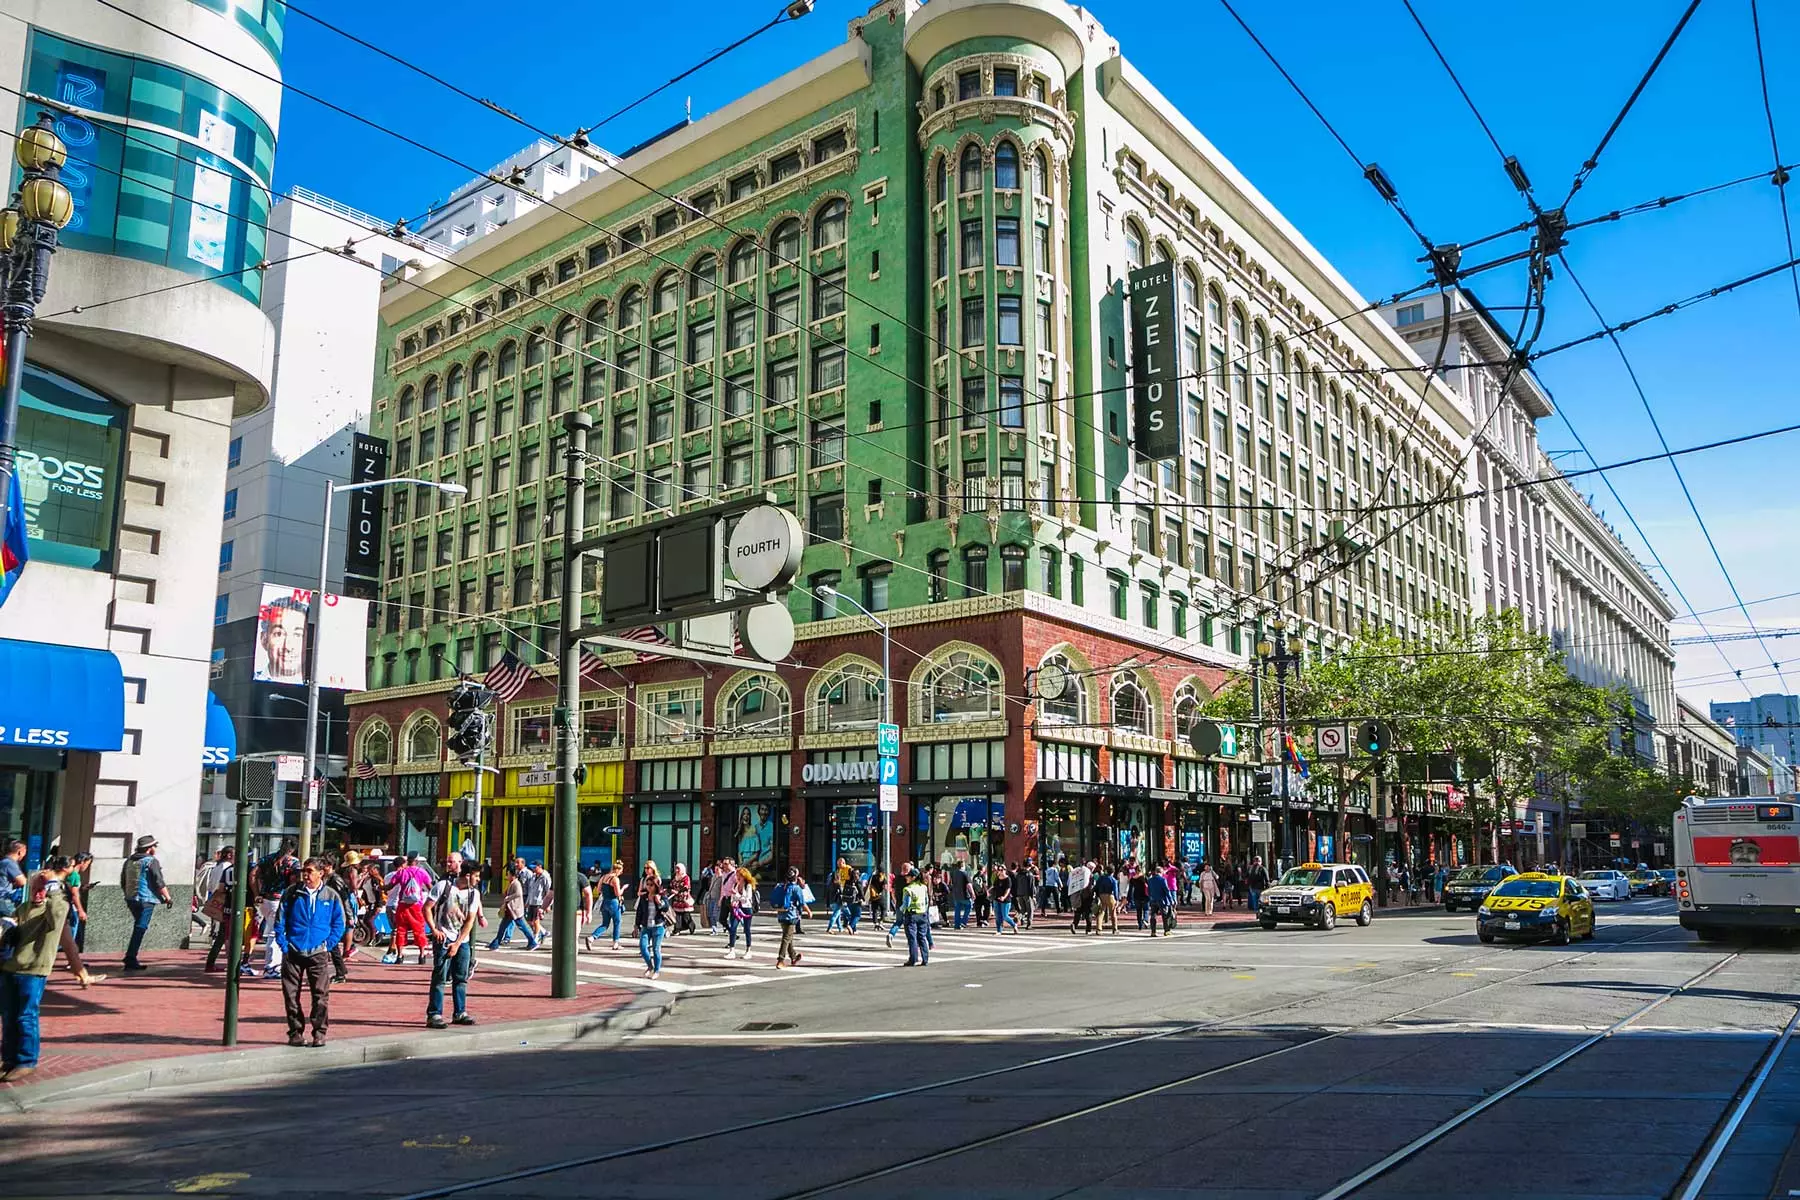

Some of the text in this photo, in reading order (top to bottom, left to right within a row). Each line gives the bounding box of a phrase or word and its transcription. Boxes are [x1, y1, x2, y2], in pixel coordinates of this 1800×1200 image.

[1134, 273, 1168, 291] HOTEL
[1145, 295, 1164, 432] ZELOS
[358, 442, 384, 455] HOTEL
[16, 450, 104, 489] ROSS
[52, 482, 103, 500] FOR LESS
[358, 458, 376, 555] ZELOS
[737, 537, 780, 558] FOURTH
[14, 727, 70, 746] LESS
[526, 772, 551, 784] 4TH ST
[802, 761, 879, 782] OLD NAVY
[840, 837, 865, 851] 50%
[1490, 898, 1545, 909] 1575
